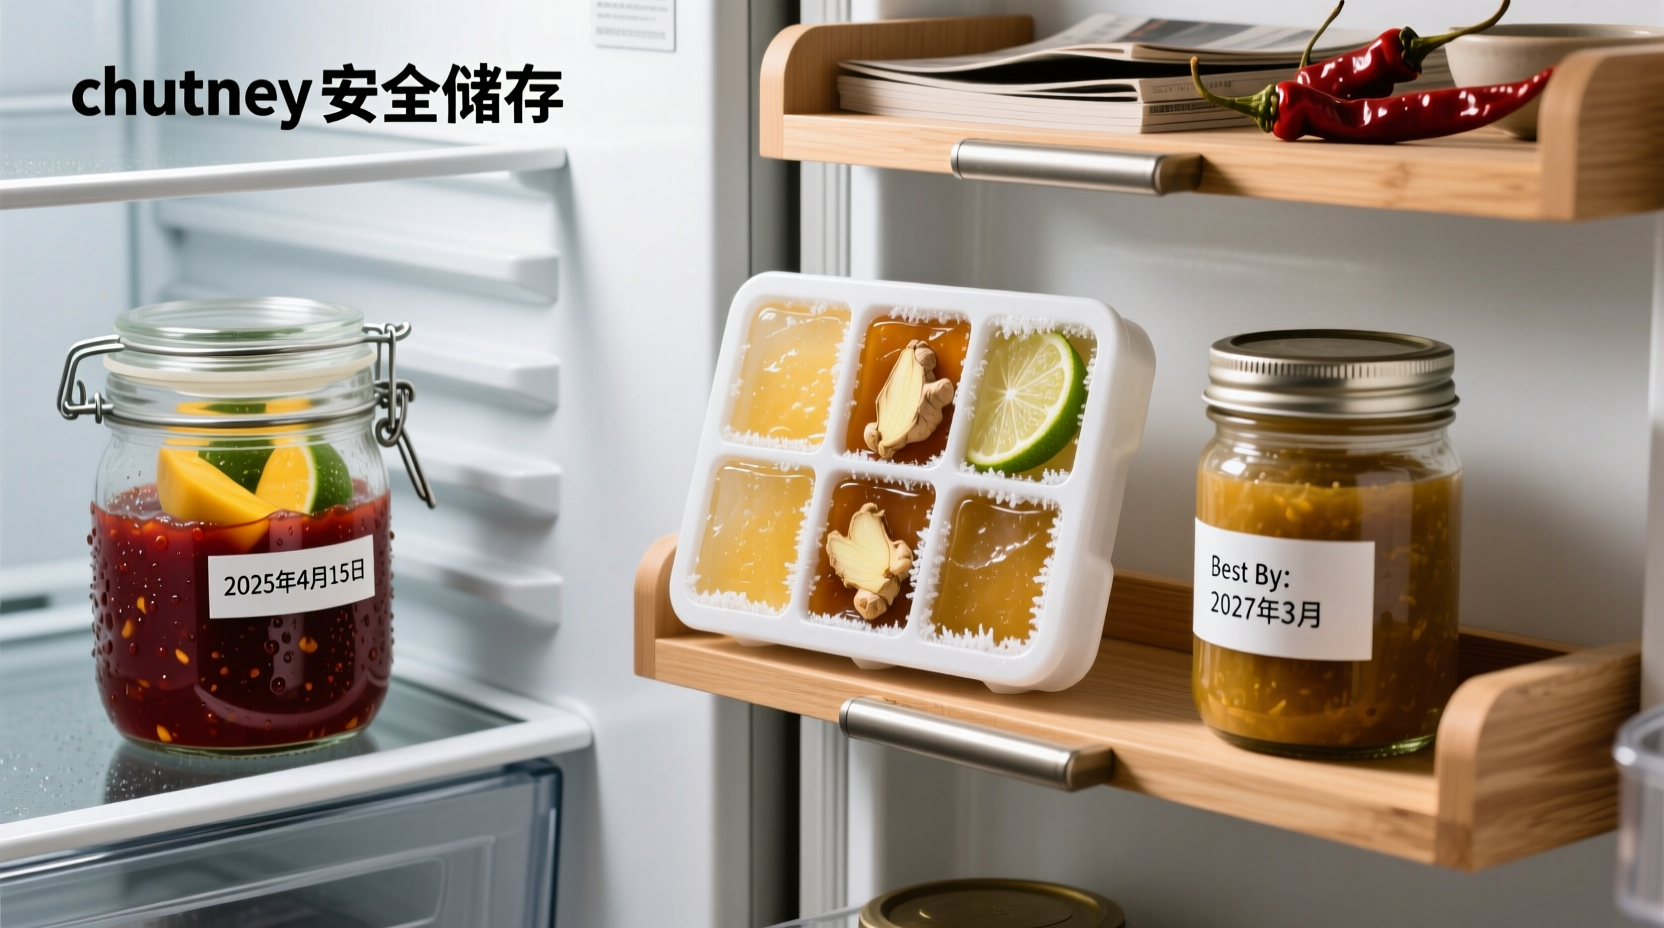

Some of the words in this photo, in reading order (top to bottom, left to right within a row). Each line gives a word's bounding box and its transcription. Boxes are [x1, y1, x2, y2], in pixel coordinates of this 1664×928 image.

[224, 558, 365, 597] 2025年4月15日
[1211, 554, 1249, 583] Best
[1255, 563, 1290, 592] By:
[1211, 590, 1321, 629] 2027年3月
